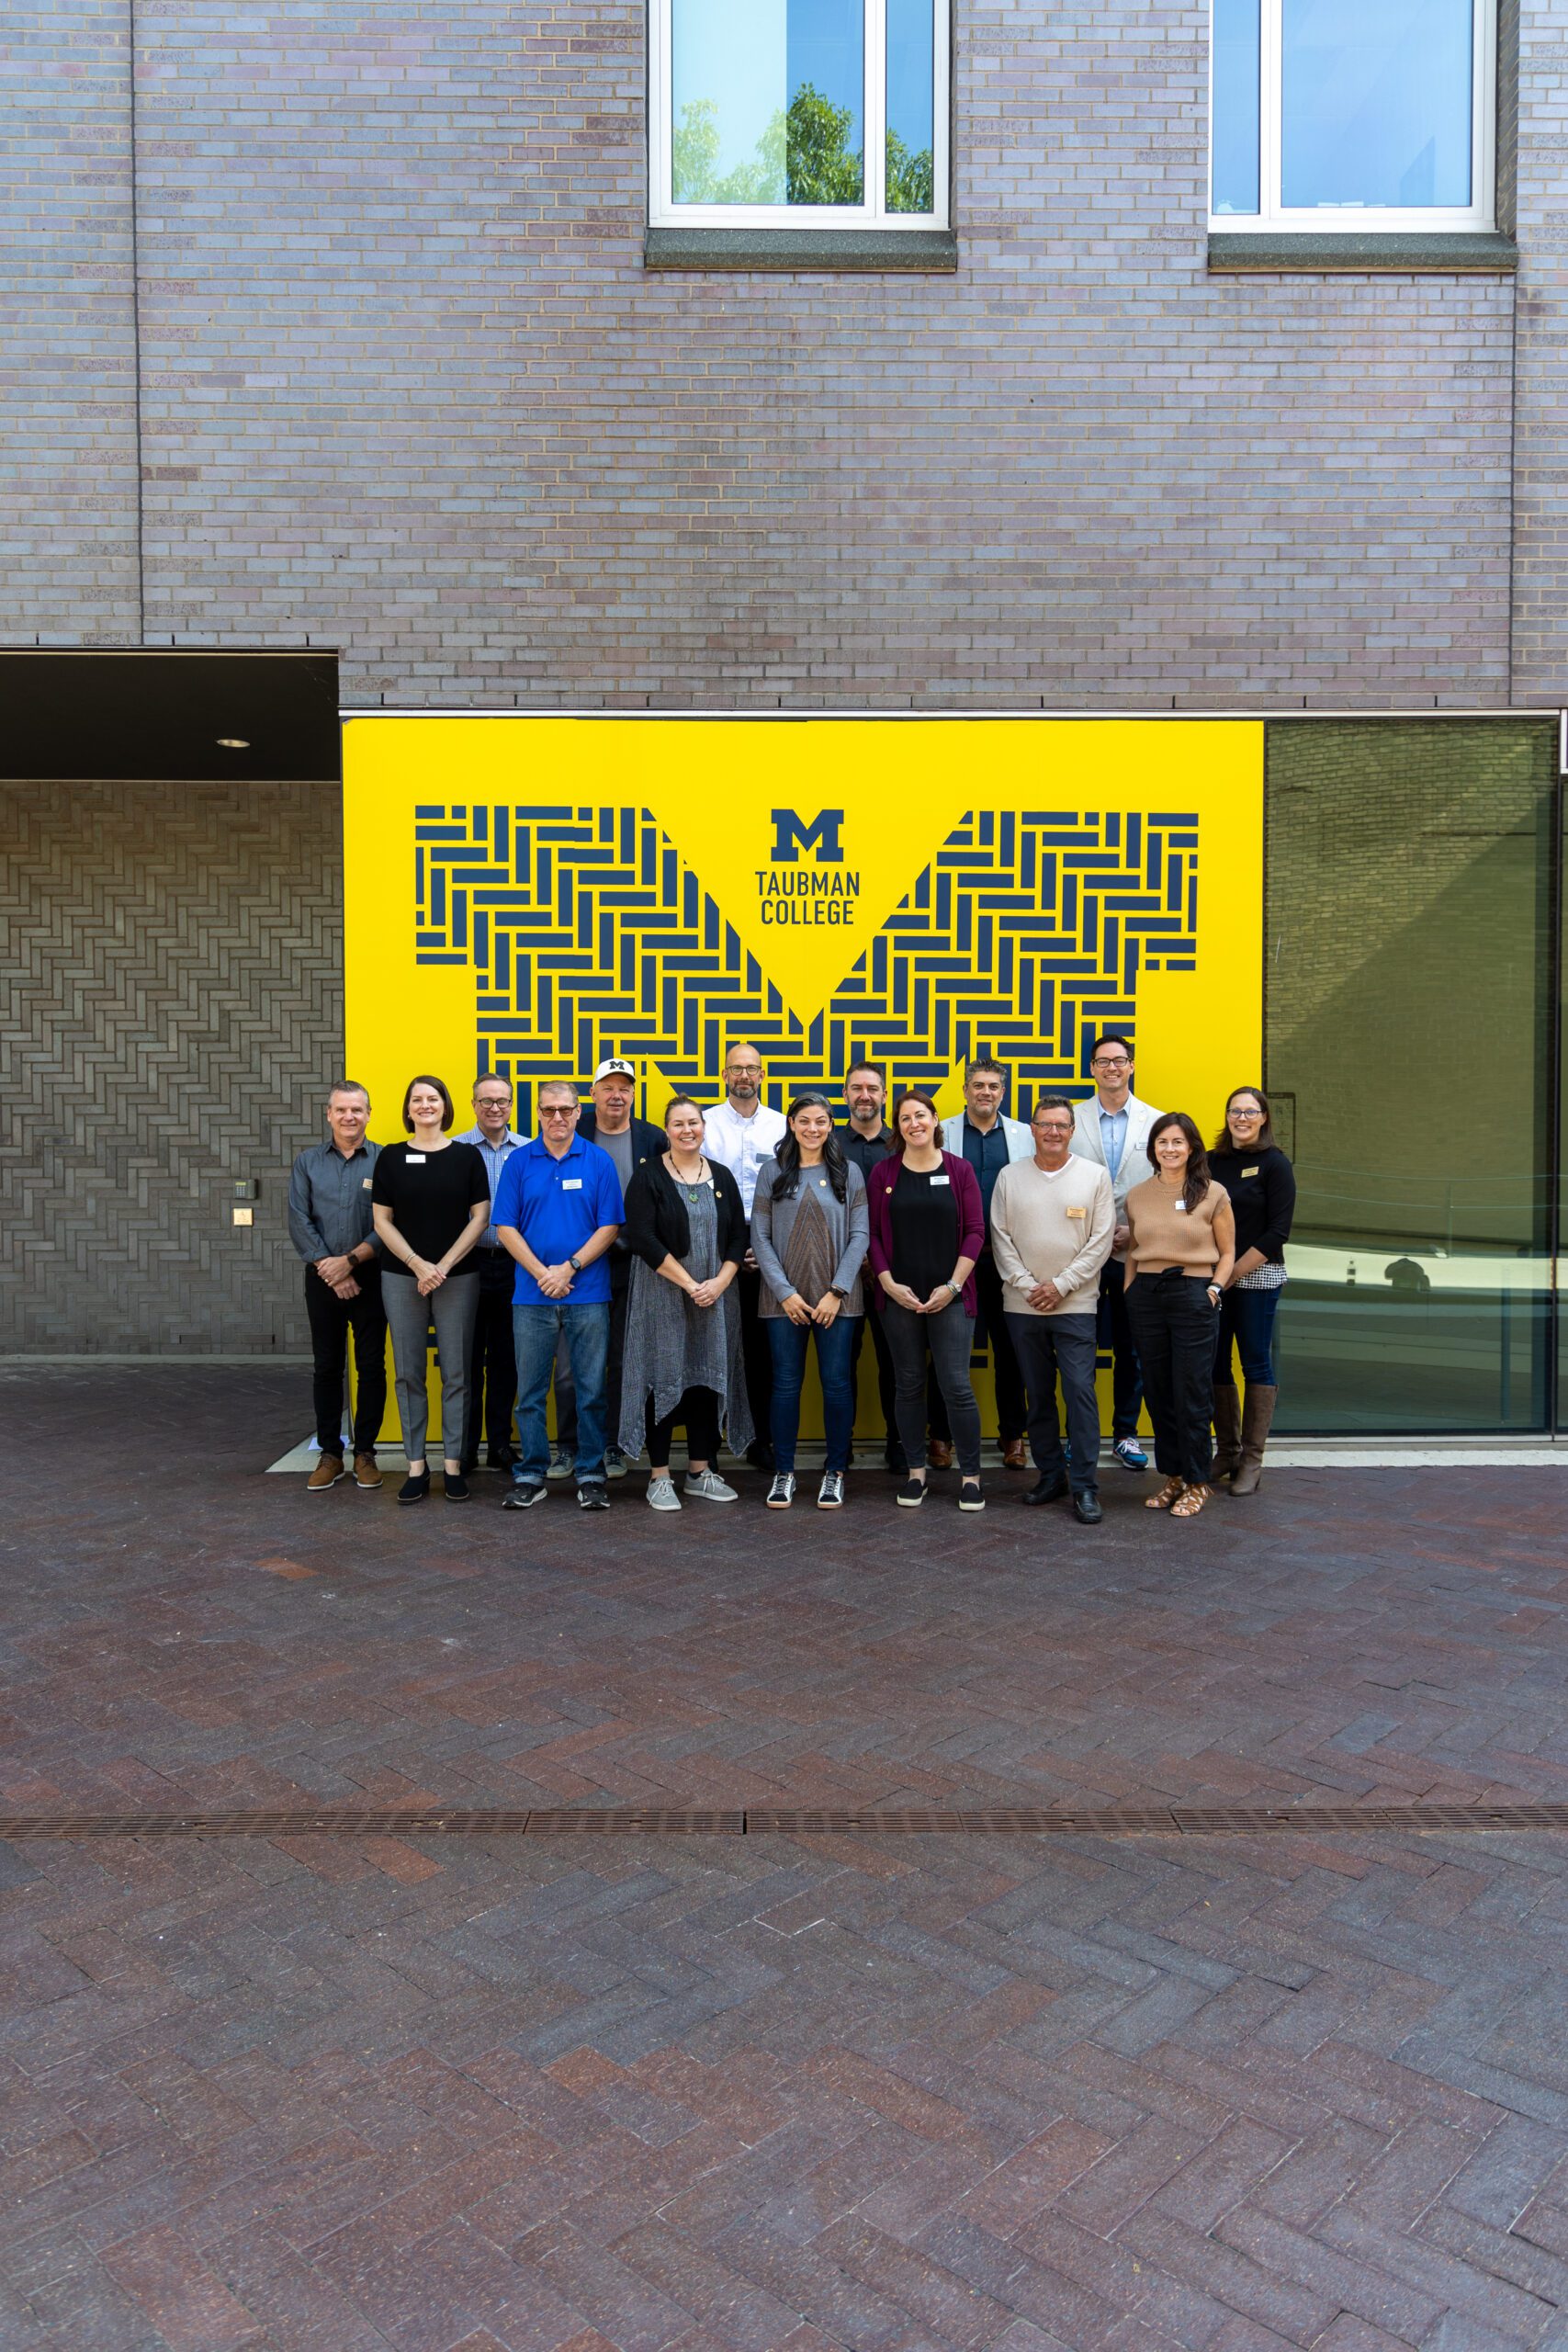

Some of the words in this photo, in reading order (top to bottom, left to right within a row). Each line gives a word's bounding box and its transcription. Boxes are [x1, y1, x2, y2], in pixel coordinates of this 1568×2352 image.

[770, 809, 844, 862] M
[755, 871, 860, 896] TAUBMAN
[761, 899, 854, 924] COLLEGE
[609, 1060, 625, 1070] M
